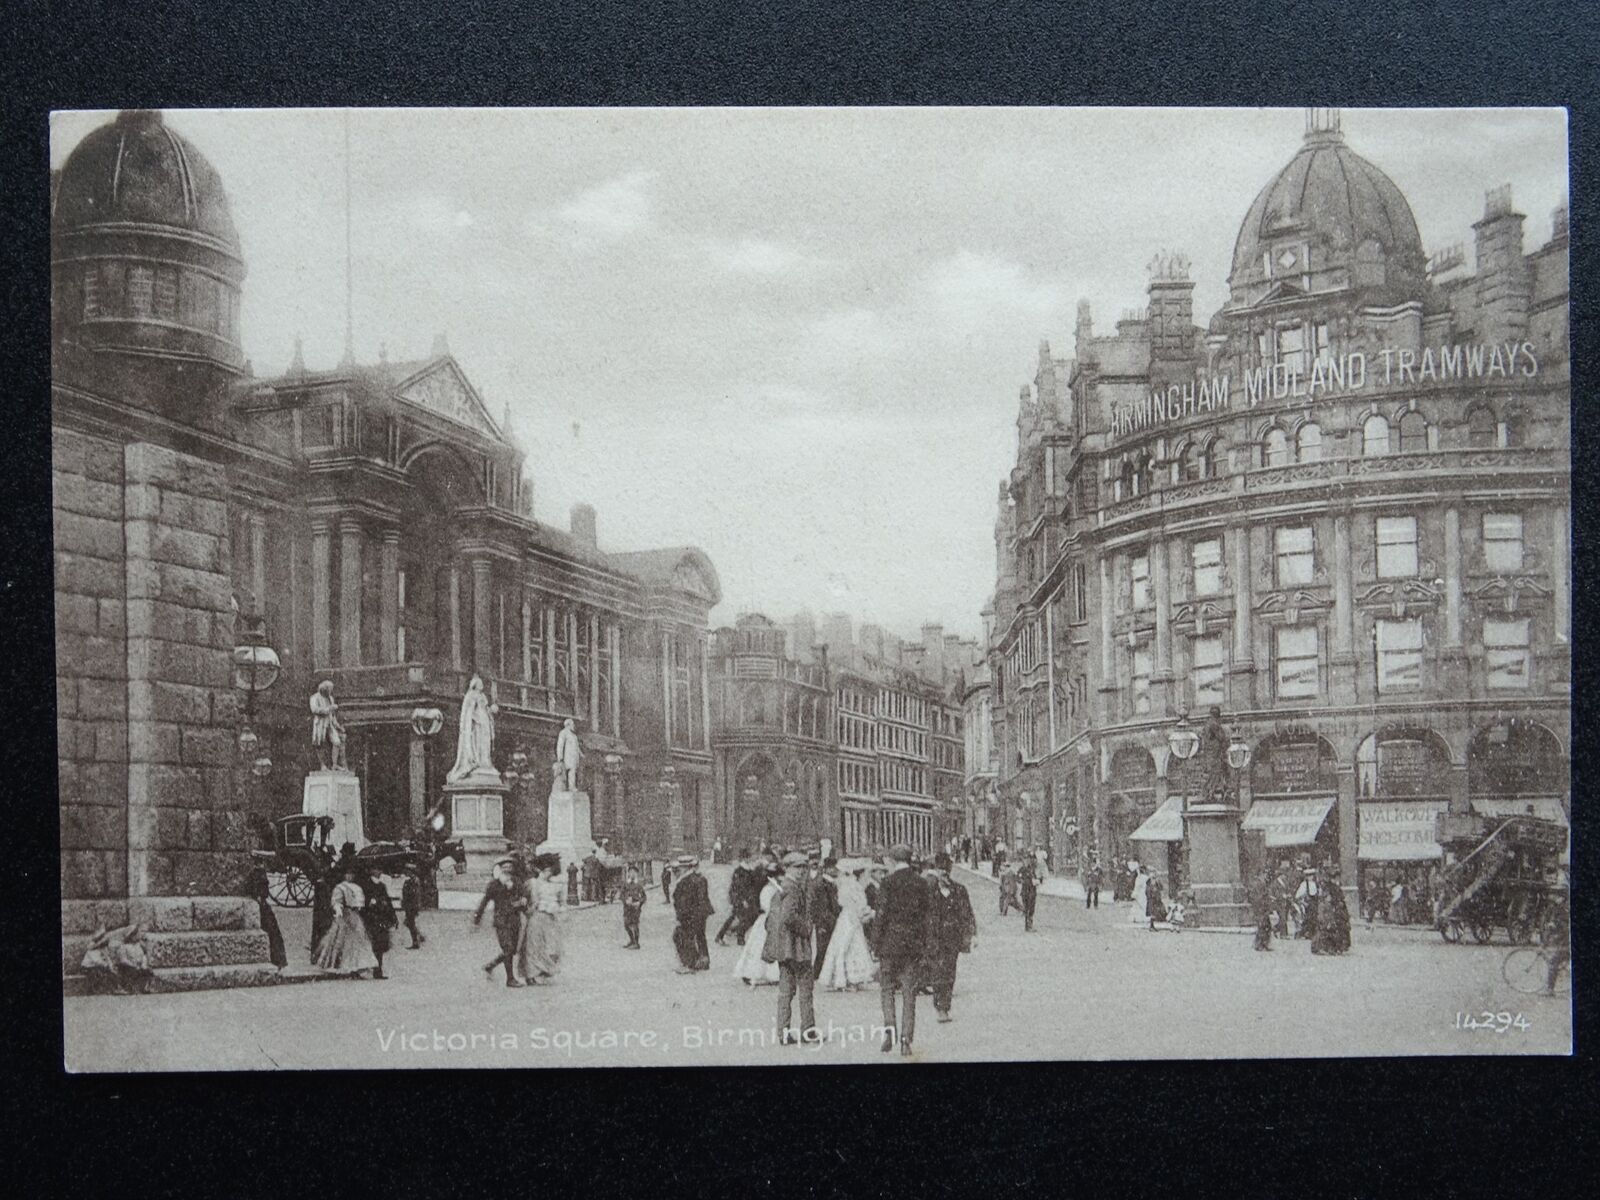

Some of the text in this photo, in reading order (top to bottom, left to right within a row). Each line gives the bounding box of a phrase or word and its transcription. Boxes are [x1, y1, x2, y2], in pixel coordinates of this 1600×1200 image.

[1111, 341, 1539, 437] BIRMINGHAM MIDLAND TRAMWAYS
